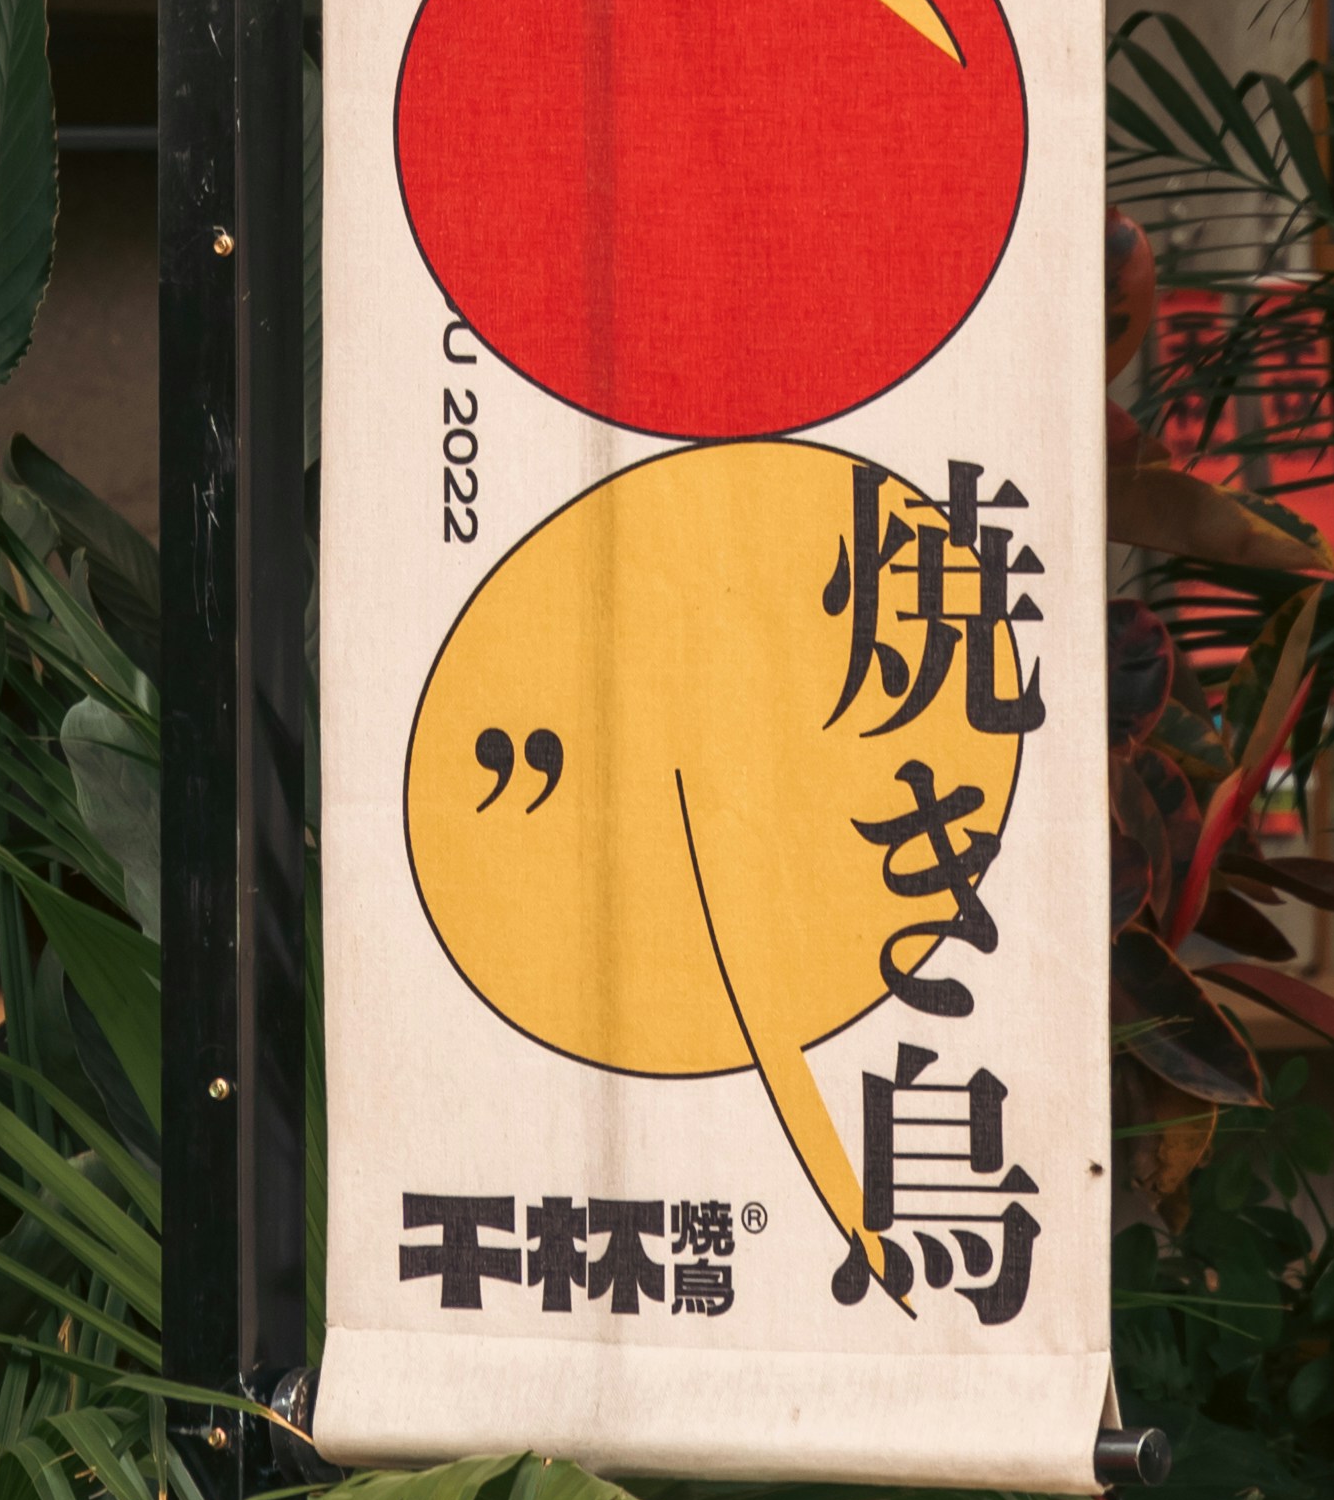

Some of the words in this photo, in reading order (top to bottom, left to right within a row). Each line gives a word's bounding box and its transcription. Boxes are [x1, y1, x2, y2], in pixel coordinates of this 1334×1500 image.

[442, 387, 479, 544] 2022
[821, 459, 1047, 1327] 焼き鳥
